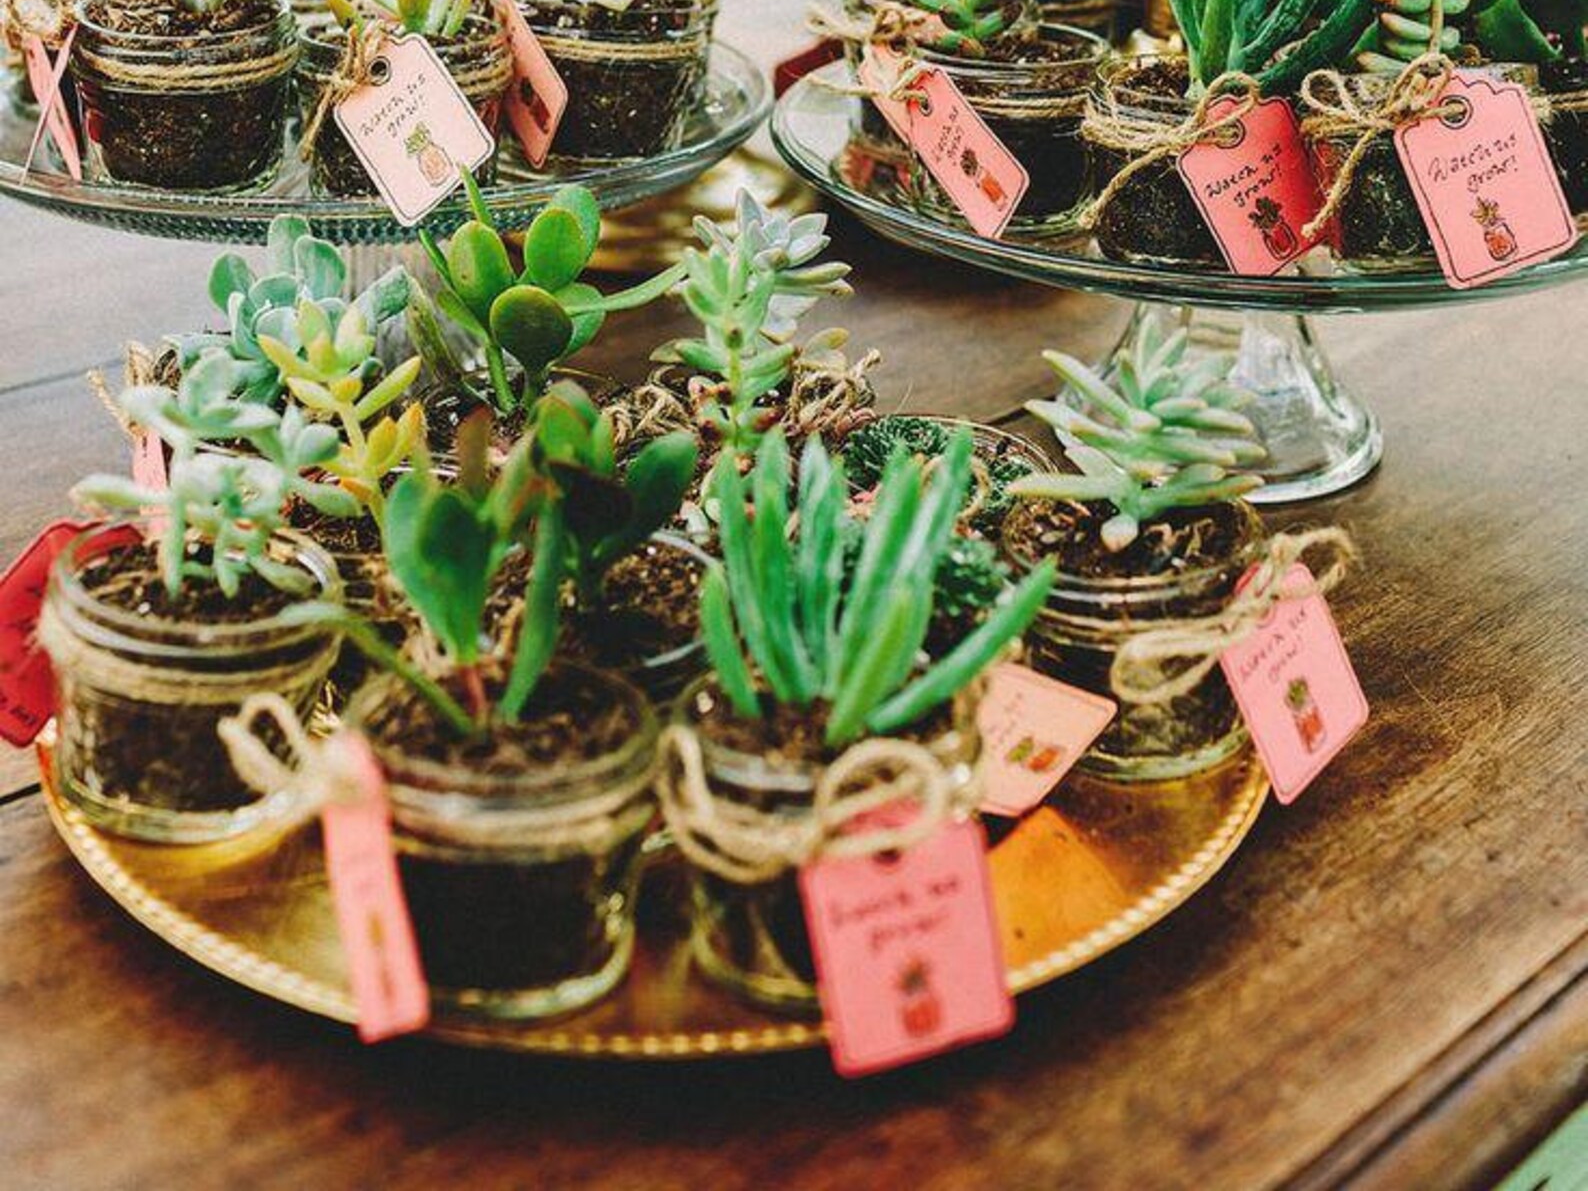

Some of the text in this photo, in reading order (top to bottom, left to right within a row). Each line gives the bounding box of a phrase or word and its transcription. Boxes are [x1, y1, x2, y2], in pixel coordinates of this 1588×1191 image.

[1204, 142, 1282, 197] Watch us
[1428, 132, 1517, 182] Watch us
[1467, 155, 1518, 193] grow!
[1233, 163, 1283, 207] grow!
